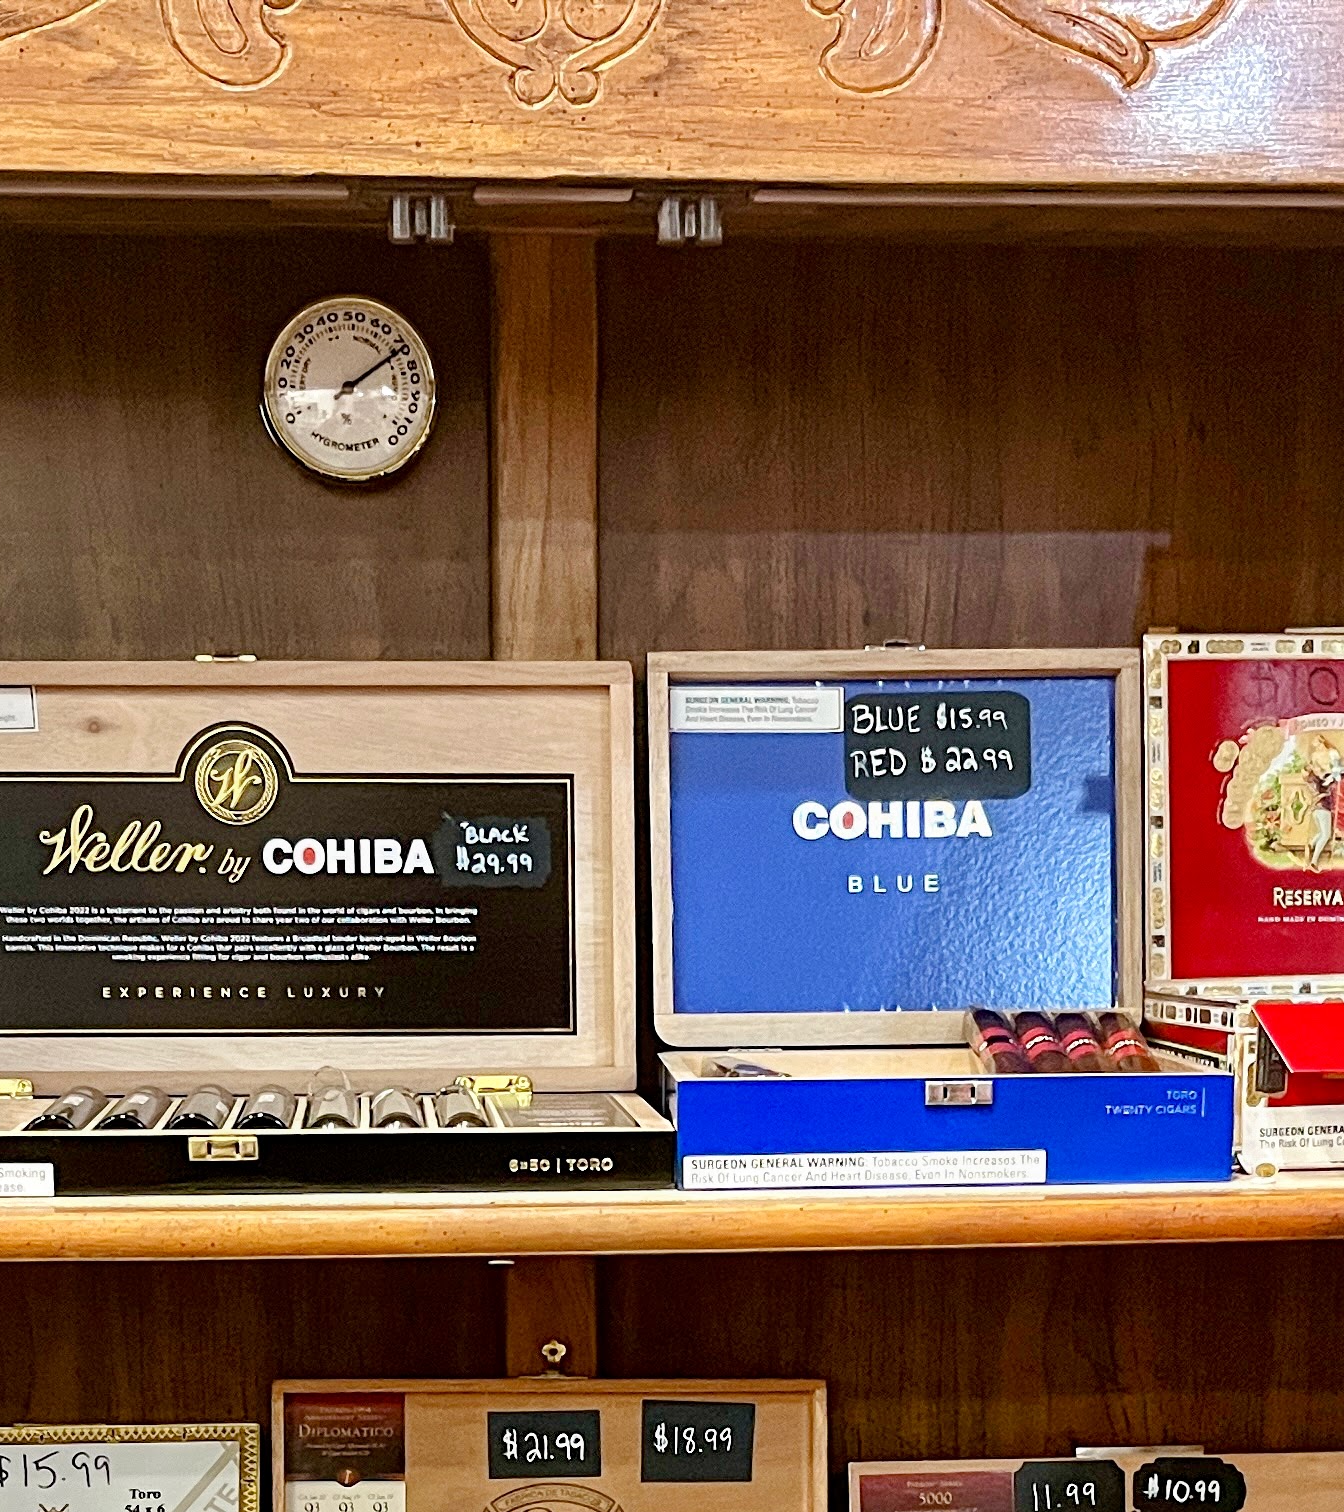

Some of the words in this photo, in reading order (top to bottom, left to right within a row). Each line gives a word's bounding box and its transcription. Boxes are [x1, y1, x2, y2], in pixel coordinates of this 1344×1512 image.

[281, 345, 296, 370] 20
[294, 323, 314, 344] 30
[316, 311, 339, 326] 40
[343, 311, 366, 323] 50
[370, 318, 392, 336] 60
[393, 334, 411, 357] 70
[407, 359, 421, 385] 80
[311, 431, 380, 452] HYGROMETER
[851, 703, 921, 735] BLUE
[936, 702, 1008, 732] $15.99
[850, 748, 907, 779] RED
[792, 801, 993, 841] COHIBA
[218, 848, 253, 885] by
[262, 837, 435, 875] COHIBA
[456, 846, 534, 876] $29.99
[847, 874, 940, 894] BLUE
[1273, 886, 1344, 907] RESERVA
[102, 985, 268, 999] EXPERIENCE
[287, 985, 386, 999] LUXURY
[1105, 1105, 1153, 1117] TWENTY
[1156, 1104, 1197, 1116] CIGARS
[566, 1157, 613, 1172] TORO
[691, 1158, 748, 1171] SURGEON
[751, 1157, 804, 1170] GENERAL
[298, 1423, 394, 1439] DIPLOMATICO
[653, 1422, 733, 1455] $18.99
[502, 1428, 586, 1463] $21.99
[129, 1488, 162, 1501] Toro
[918, 1491, 953, 1506] 5000
[1031, 1482, 1097, 1511] 11.99
[1143, 1474, 1221, 1503] $10.99
